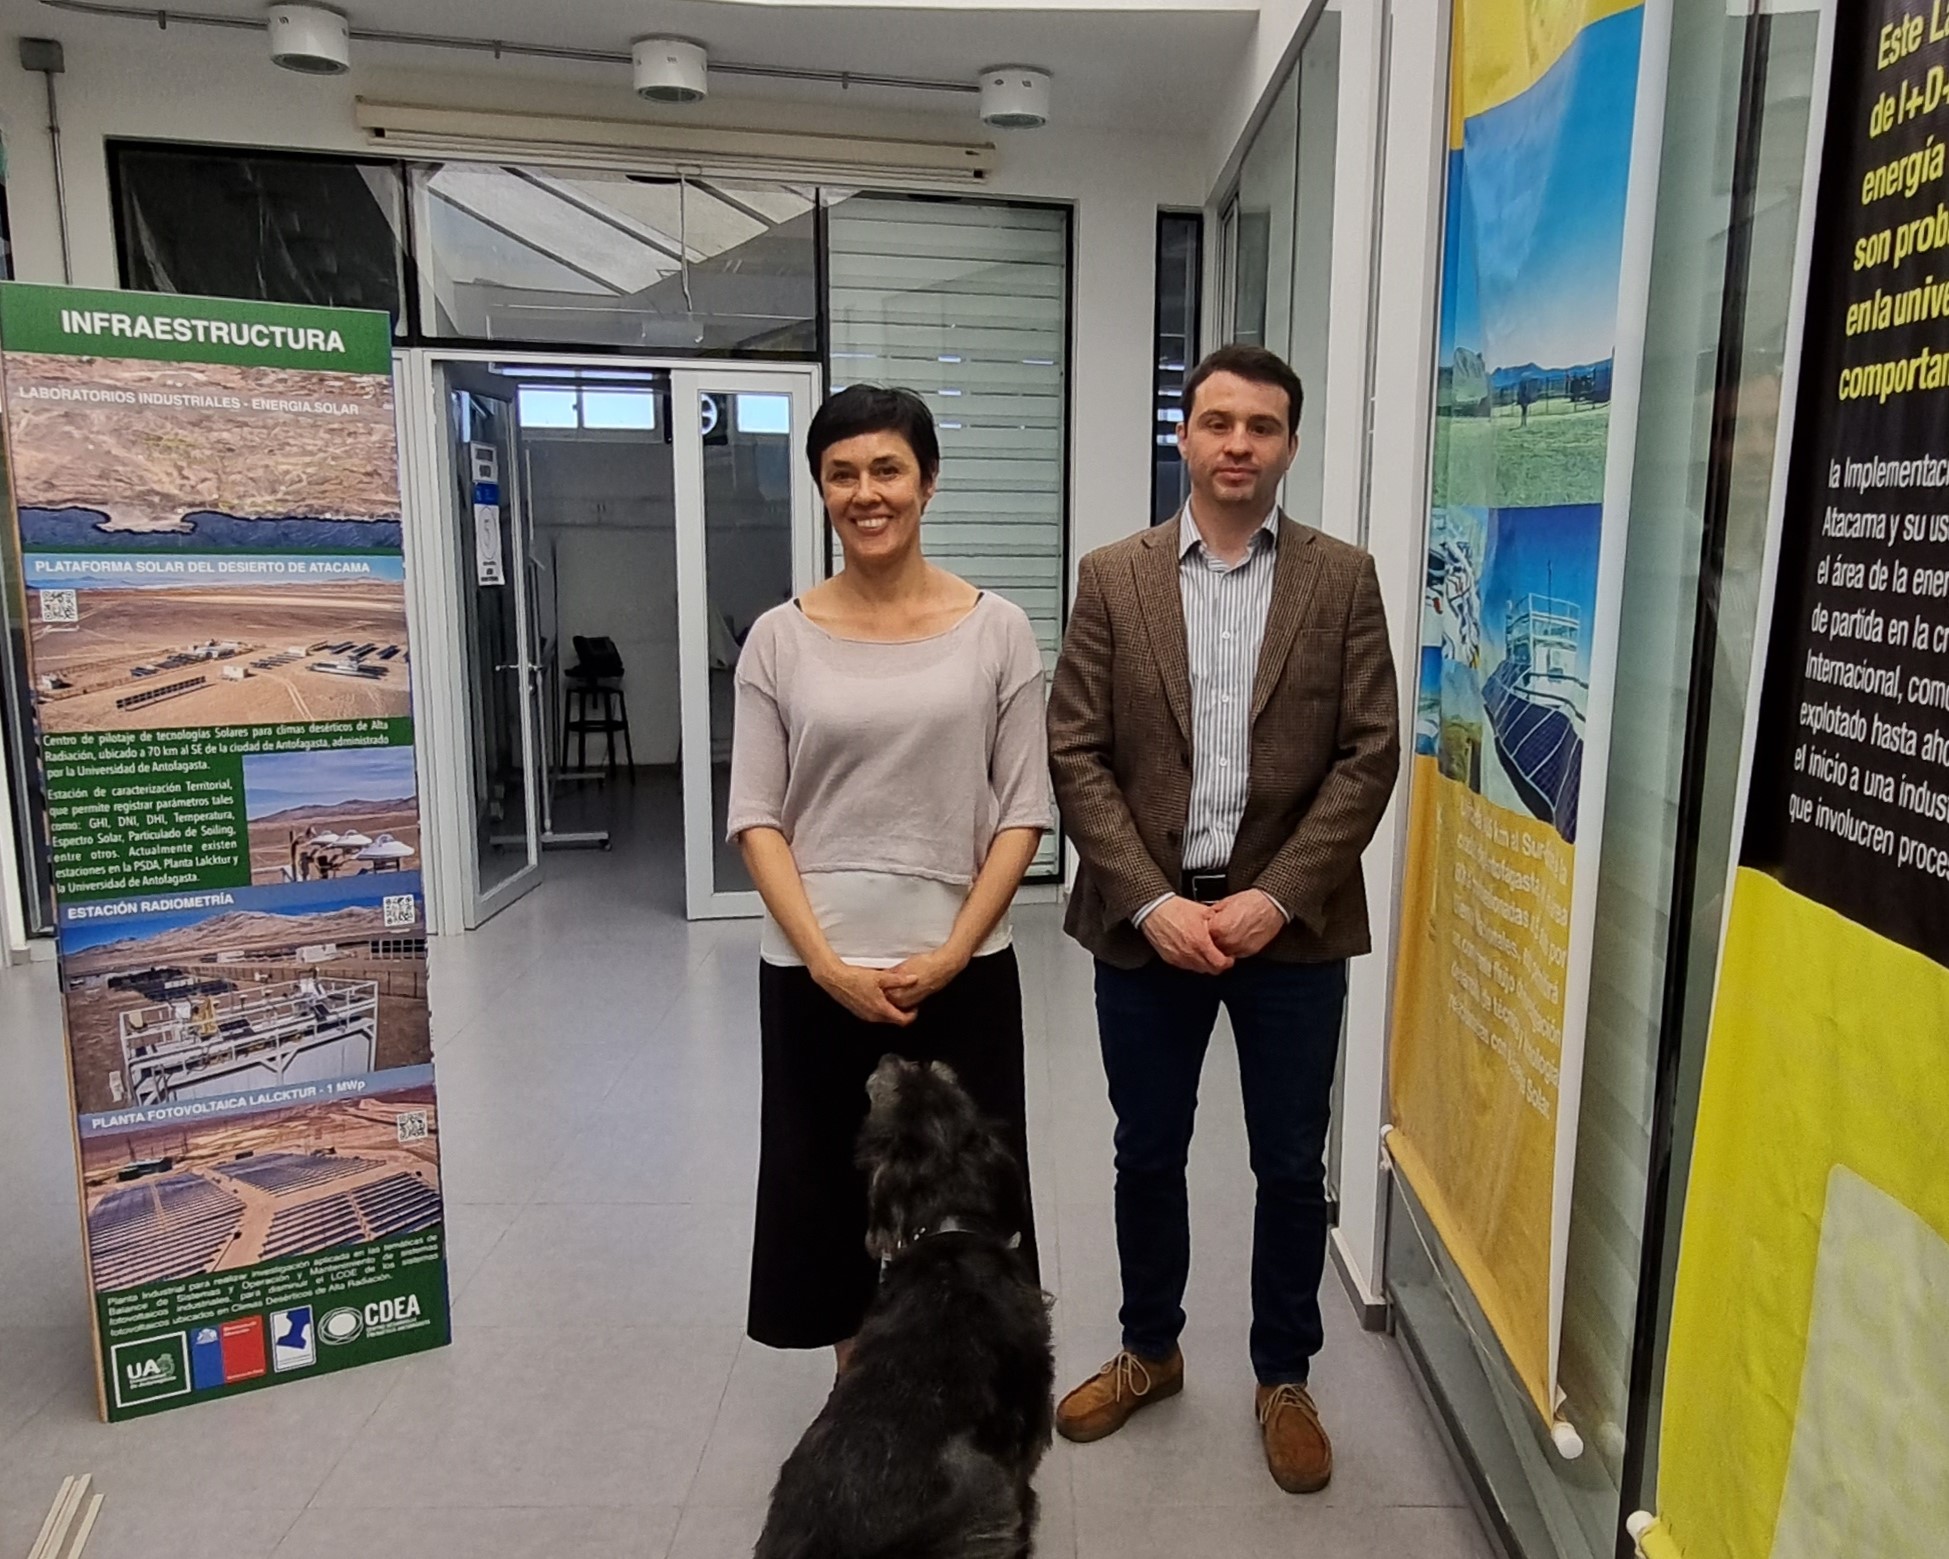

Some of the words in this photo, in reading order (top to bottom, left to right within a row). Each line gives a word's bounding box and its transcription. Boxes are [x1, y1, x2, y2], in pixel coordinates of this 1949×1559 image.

[1878, 12, 1924, 71] Este
[1869, 91, 1896, 139] de
[1862, 134, 1945, 205] energía
[1853, 229, 1891, 271] son
[1893, 202, 1949, 269] prob
[60, 309, 346, 353] INFRAESTRUCTURA
[19, 386, 135, 403] LABORATORIOS
[138, 392, 241, 409] INDUSTRIALES
[314, 402, 359, 415] SOLAR
[1828, 458, 1840, 488] la
[1822, 506, 1886, 539] Atacama
[1888, 514, 1900, 547] y
[1903, 514, 1927, 541] su
[1929, 514, 1949, 542] us
[35, 560, 133, 573] PLATAFORMA
[136, 561, 184, 573] SOLAR
[188, 562, 214, 573] DEL
[219, 561, 285, 574] DESIERTO
[288, 562, 305, 573] DE
[309, 562, 370, 573] ATACAMA
[1817, 554, 1830, 584] el
[1832, 554, 1865, 589] área
[1868, 558, 1888, 591] de
[1892, 559, 1908, 593] la
[1811, 602, 1828, 634] de
[1830, 608, 1883, 642] partida
[1888, 618, 1909, 646] en
[1912, 614, 1929, 650] la
[1805, 648, 1902, 704] Internacional,
[43, 735, 77, 746] Centro
[81, 734, 94, 744] de
[98, 732, 135, 745] pilotaje
[140, 731, 152, 742] de
[215, 727, 248, 738] Solares
[252, 727, 272, 738] para
[276, 724, 305, 735] climas
[309, 721, 353, 733] desérticos
[357, 721, 368, 731] de
[371, 721, 388, 730] Alta
[1800, 701, 1867, 742] explotado
[1871, 712, 1917, 756] hasta
[45, 751, 96, 762] Radiación,
[99, 748, 137, 759] ubicado
[140, 749, 145, 757] a
[148, 746, 160, 756] 70
[162, 746, 178, 756] km
[181, 744, 188, 754] al
[191, 744, 202, 754] SE
[205, 743, 217, 753] de
[219, 742, 228, 753] la
[229, 741, 259, 752] ciudad
[262, 740, 274, 749] de
[276, 738, 330, 751] Antofagasta,
[332, 735, 389, 747] administrado
[47, 769, 63, 780] por
[66, 767, 75, 776] la
[78, 763, 135, 776] Universidad
[138, 762, 150, 772] de
[152, 759, 210, 773] Antofagasta.
[1794, 743, 1806, 772] el
[1808, 745, 1848, 786] inicio
[1849, 766, 1859, 792] a
[1863, 770, 1895, 803] una
[1899, 773, 1949, 824] indus
[48, 788, 88, 799] Estación
[93, 787, 106, 797] de
[112, 782, 181, 796] caracterización
[186, 779, 232, 790] Territorial,
[50, 806, 68, 818] que
[72, 803, 110, 816] permite
[113, 799, 153, 813] registrar
[156, 798, 209, 811] parámetros
[212, 795, 233, 805] tales
[51, 822, 81, 831] como:
[89, 817, 111, 829] GHI,
[118, 816, 139, 827] DNI,
[147, 814, 168, 825] DHI,
[174, 810, 235, 823] Temperatura,
[52, 836, 93, 848] Espectro
[97, 833, 124, 844] Solar,
[128, 830, 181, 842] Particulado
[185, 829, 197, 838] de
[54, 853, 81, 862] entre
[91, 850, 120, 859] otros.
[129, 843, 193, 857] Actualmente
[202, 840, 237, 851] existen
[1789, 793, 1813, 823] que
[1815, 797, 1894, 856] involucren
[1897, 835, 1949, 881] proce
[55, 865, 106, 878] estaciones
[108, 865, 120, 873] en
[123, 862, 132, 872] la
[164, 858, 193, 868] Planta
[232, 855, 238, 865] y
[57, 883, 66, 894] la
[68, 877, 126, 893] Universidad
[128, 877, 140, 887] de
[142, 873, 199, 886] Antofagasta.
[68, 902, 138, 919] ESTACIÓN
[141, 893, 234, 912] RADIOMETRÍA
[92, 1111, 145, 1129] PLANTA
[148, 1098, 247, 1121] FOTOVOLTAICA
[249, 1086, 316, 1106] LALCKTUR
[327, 1083, 333, 1093] 1
[336, 1080, 366, 1093] MWp
[188, 1281, 210, 1291] para
[240, 1290, 261, 1301] para
[331, 1269, 357, 1281] LCOE
[328, 1284, 345, 1292] Alta
[365, 1294, 421, 1326] CDEA
[127, 1359, 160, 1379] UA
